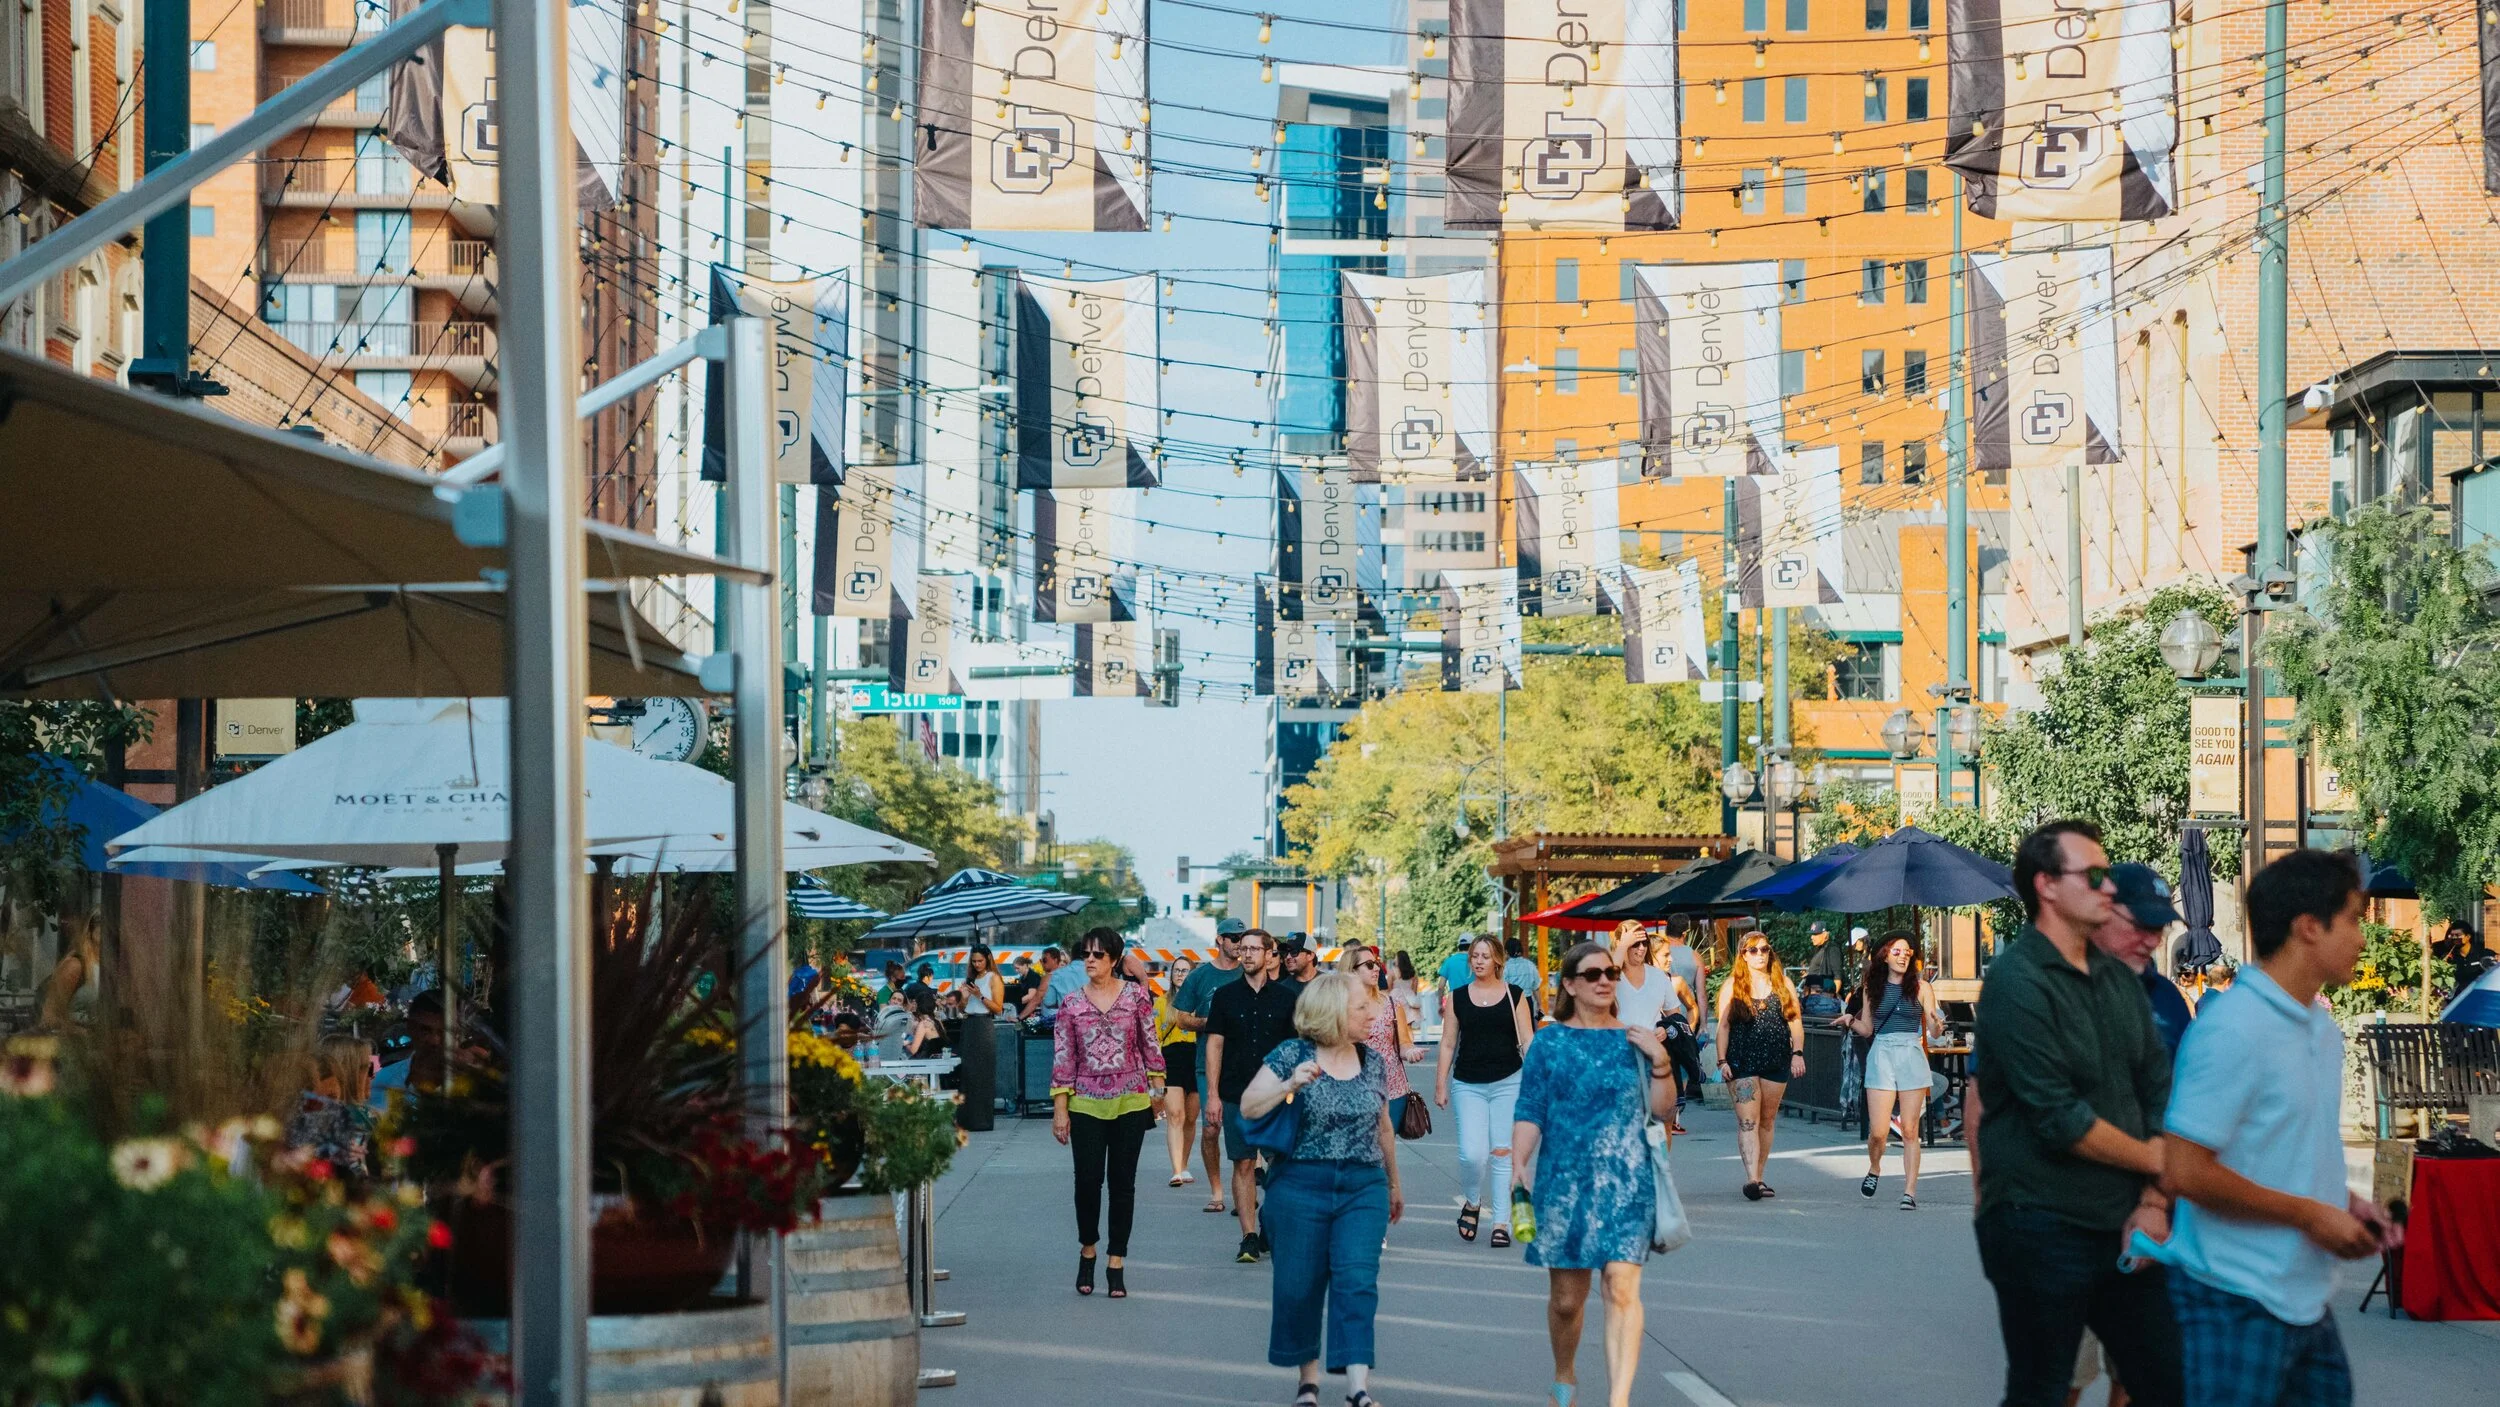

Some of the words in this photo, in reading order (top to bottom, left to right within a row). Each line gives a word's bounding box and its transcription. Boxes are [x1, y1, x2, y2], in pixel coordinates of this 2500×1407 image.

[1076, 292, 1102, 397] Denver
[1404, 287, 1429, 391] Denver
[1696, 282, 1722, 386] Denver
[2033, 270, 2060, 375] Denver
[1320, 479, 1340, 555] Denver
[1558, 471, 1578, 550] Denver
[881, 688, 927, 708] 15th
[938, 697, 957, 706] 1500
[247, 724, 285, 735] Denver
[2195, 727, 2221, 737] GOOD
[2224, 727, 2235, 737] TO
[2195, 739, 2214, 749] SEE
[2216, 739, 2235, 749] YOU
[2195, 753, 2235, 766] AGAIN
[424, 794, 441, 804] &
